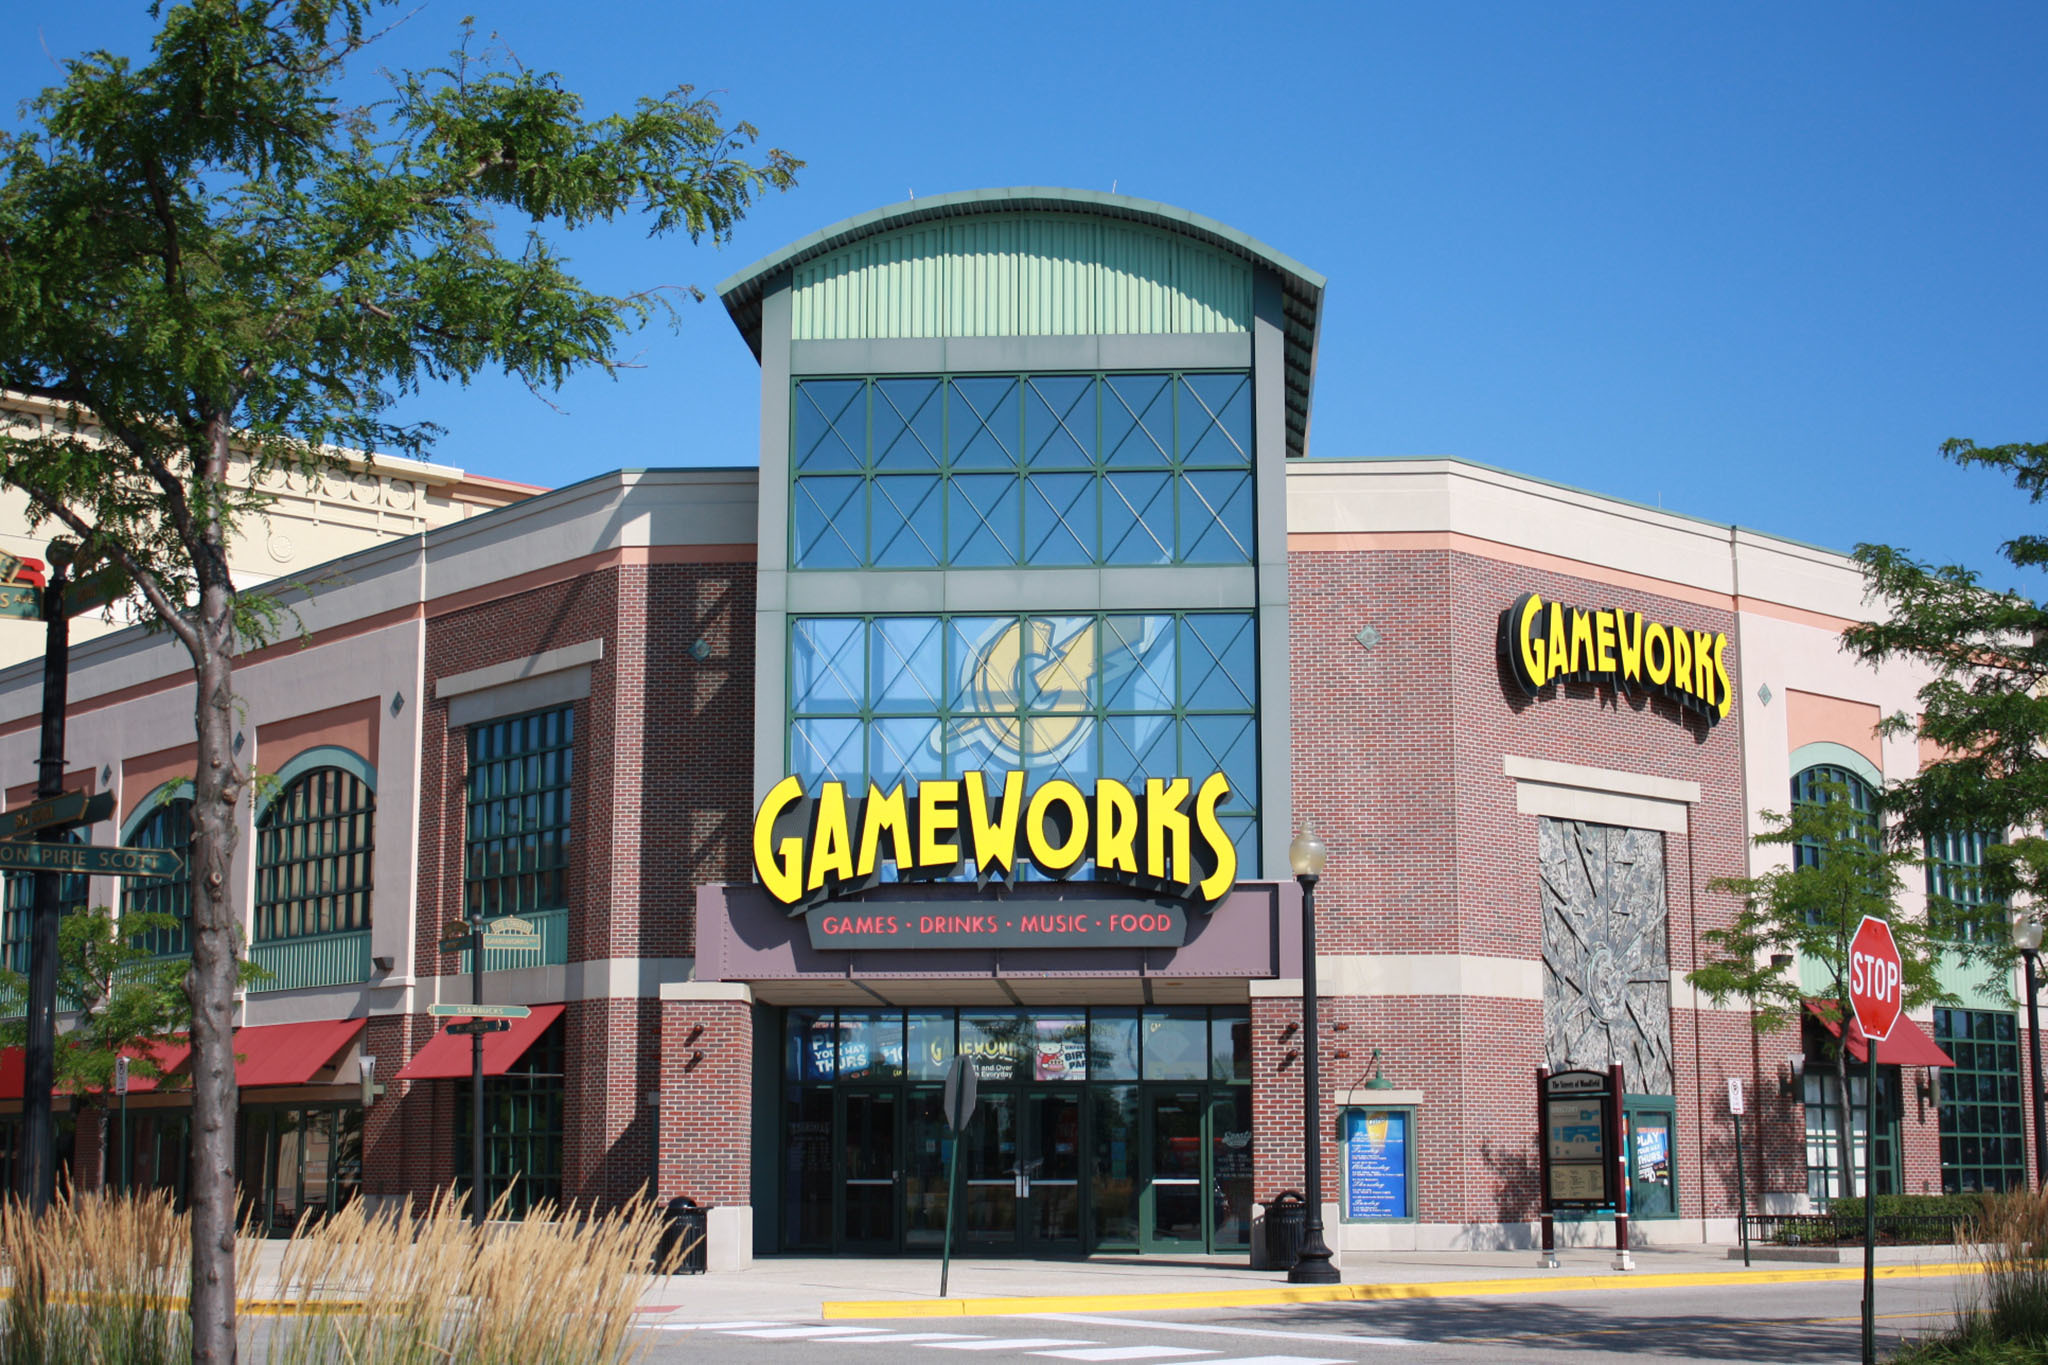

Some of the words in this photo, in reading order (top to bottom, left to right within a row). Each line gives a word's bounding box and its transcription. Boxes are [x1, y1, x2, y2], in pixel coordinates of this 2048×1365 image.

[14, 593, 34, 604] AVE
[1521, 593, 1731, 717] GAMEWORKS
[754, 772, 1235, 903] GAMEWORKS
[41, 848, 88, 866] PIRIE
[99, 852, 160, 869] SCOTT
[822, 916, 898, 935] GAMES
[920, 915, 999, 934] DRINKS
[1020, 914, 1088, 933] MUSIC
[1109, 913, 1172, 932] FOOD
[1852, 951, 1898, 1003] STOP
[456, 1006, 505, 1016] STARBUCKS
[981, 1063, 995, 1072] and
[995, 1063, 1013, 1072] Over
[981, 1071, 1014, 1080] Everyday
